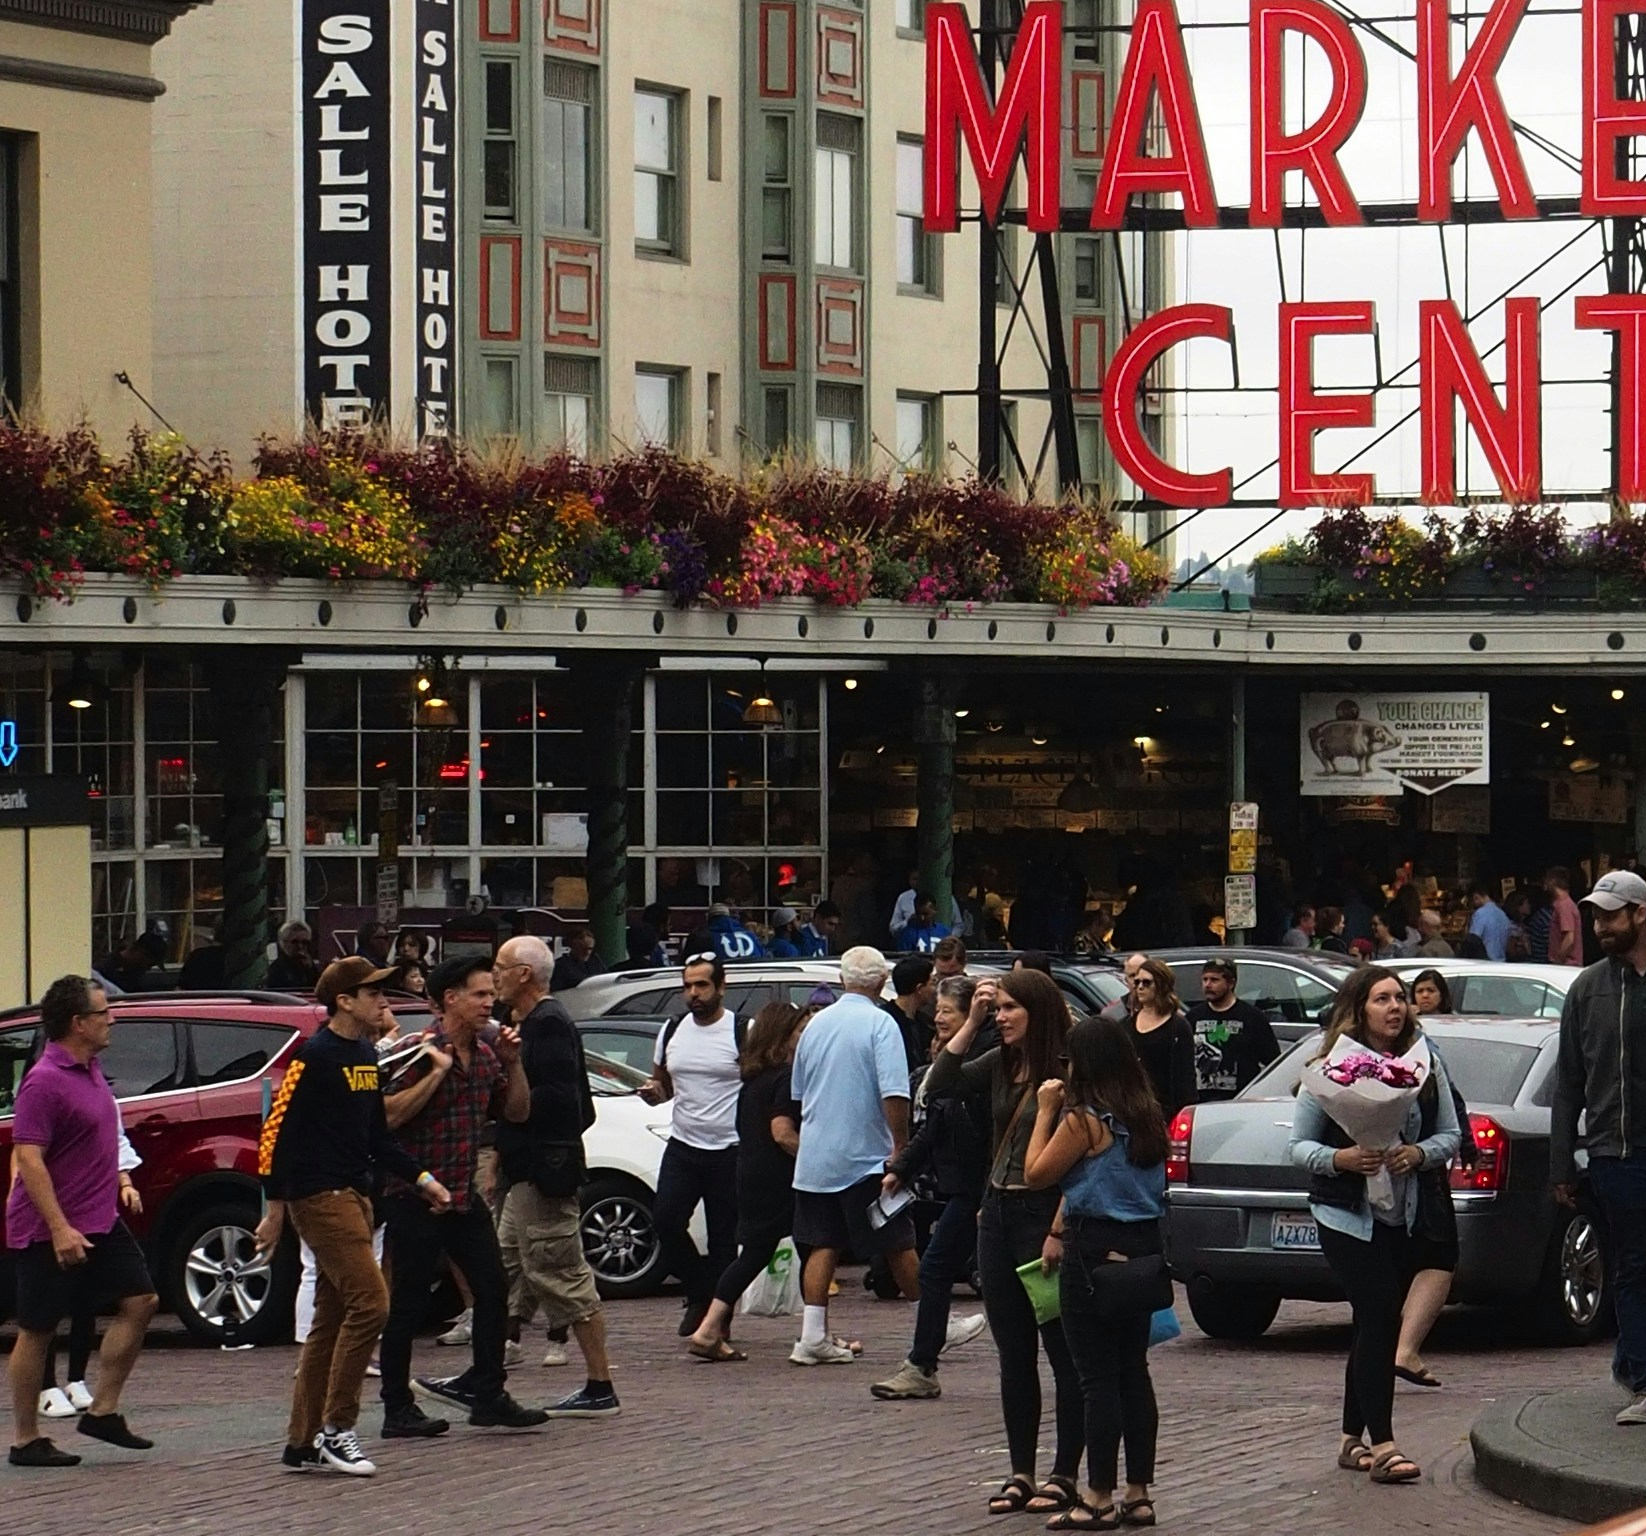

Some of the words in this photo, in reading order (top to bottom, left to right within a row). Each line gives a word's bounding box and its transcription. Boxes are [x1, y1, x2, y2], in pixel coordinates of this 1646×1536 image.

[313, 15, 373, 232] SALLE
[421, 31, 448, 242] SALLE
[1377, 701, 1420, 721] YOUR
[1421, 701, 1485, 721] CHANGE
[1395, 723, 1447, 731] CHANGES
[1449, 723, 1484, 731] LIVES!
[0, 788, 28, 809] ank
[342, 1066, 378, 1092] VANS
